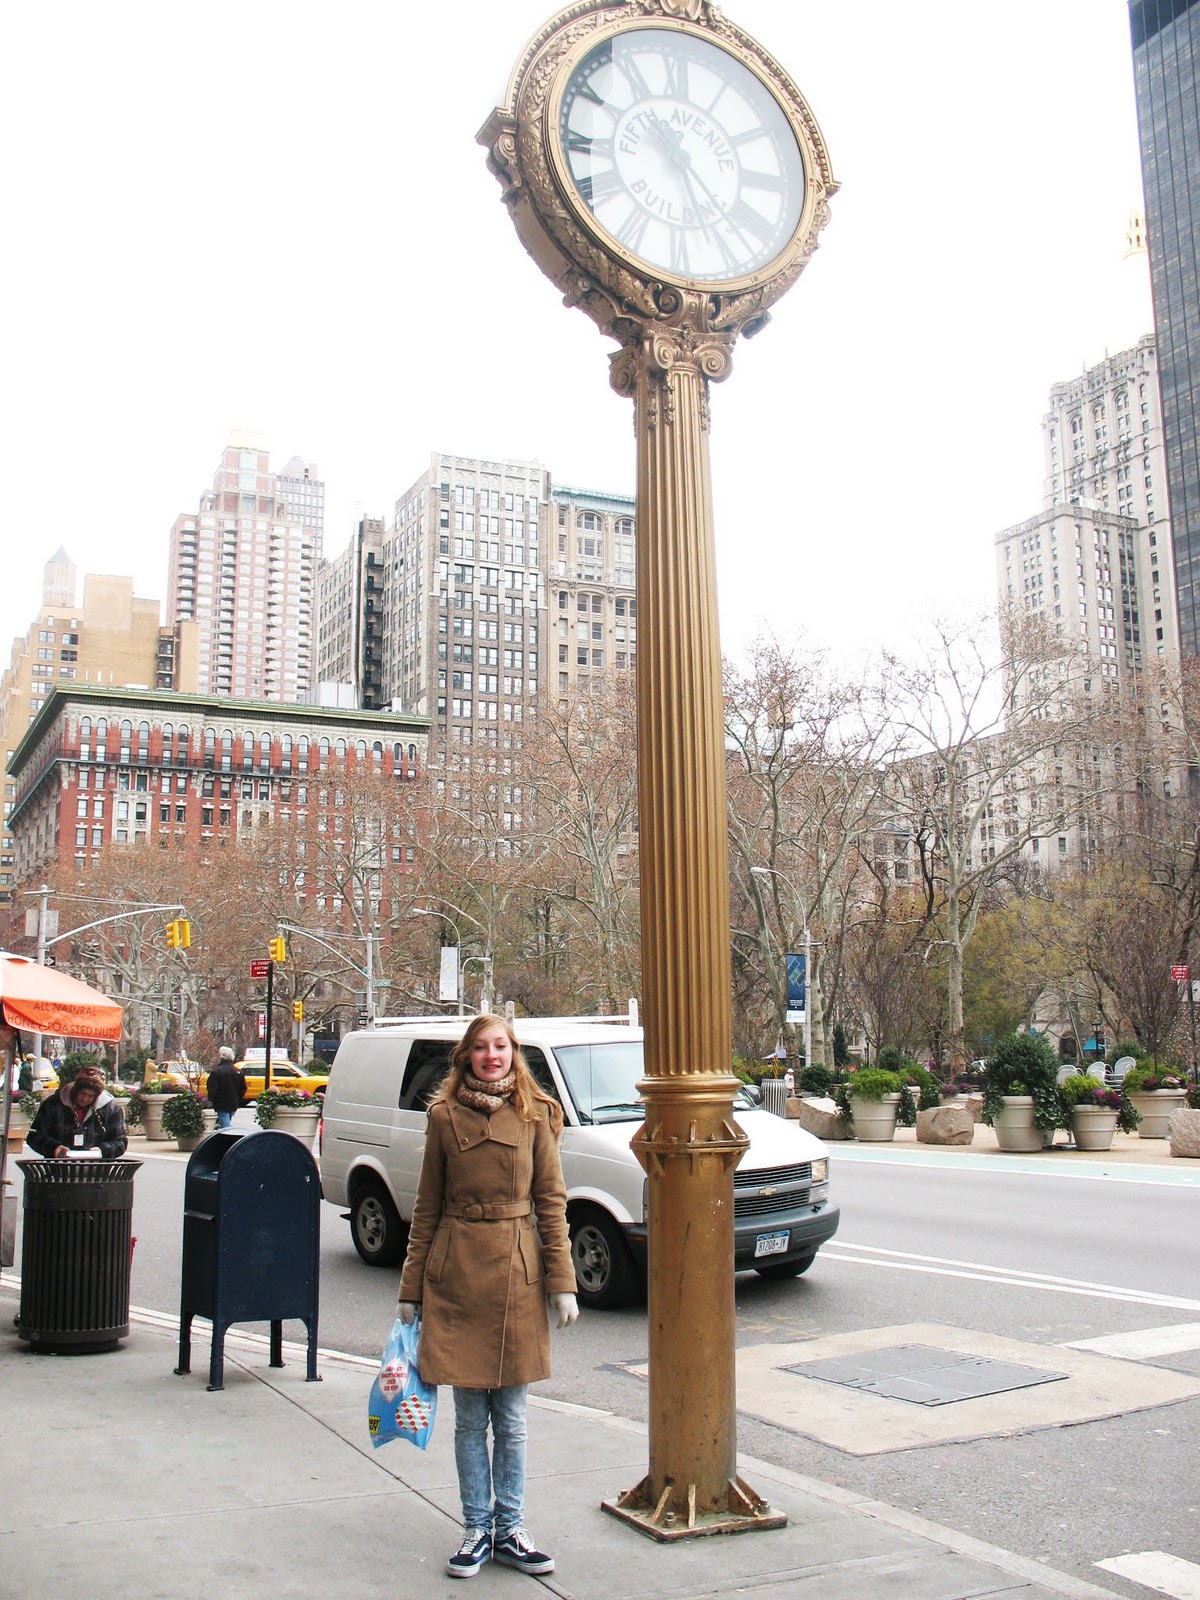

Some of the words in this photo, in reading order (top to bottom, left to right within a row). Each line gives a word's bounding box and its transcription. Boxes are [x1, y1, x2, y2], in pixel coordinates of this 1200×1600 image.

[619, 107, 658, 156] FIFTH
[670, 107, 735, 174] AVENUE
[630, 179, 727, 224] BUILDN
[33, 1001, 50, 1011] ALL
[52, 1002, 97, 1017] NATURAL
[94, 1027, 117, 1039] NUTS
